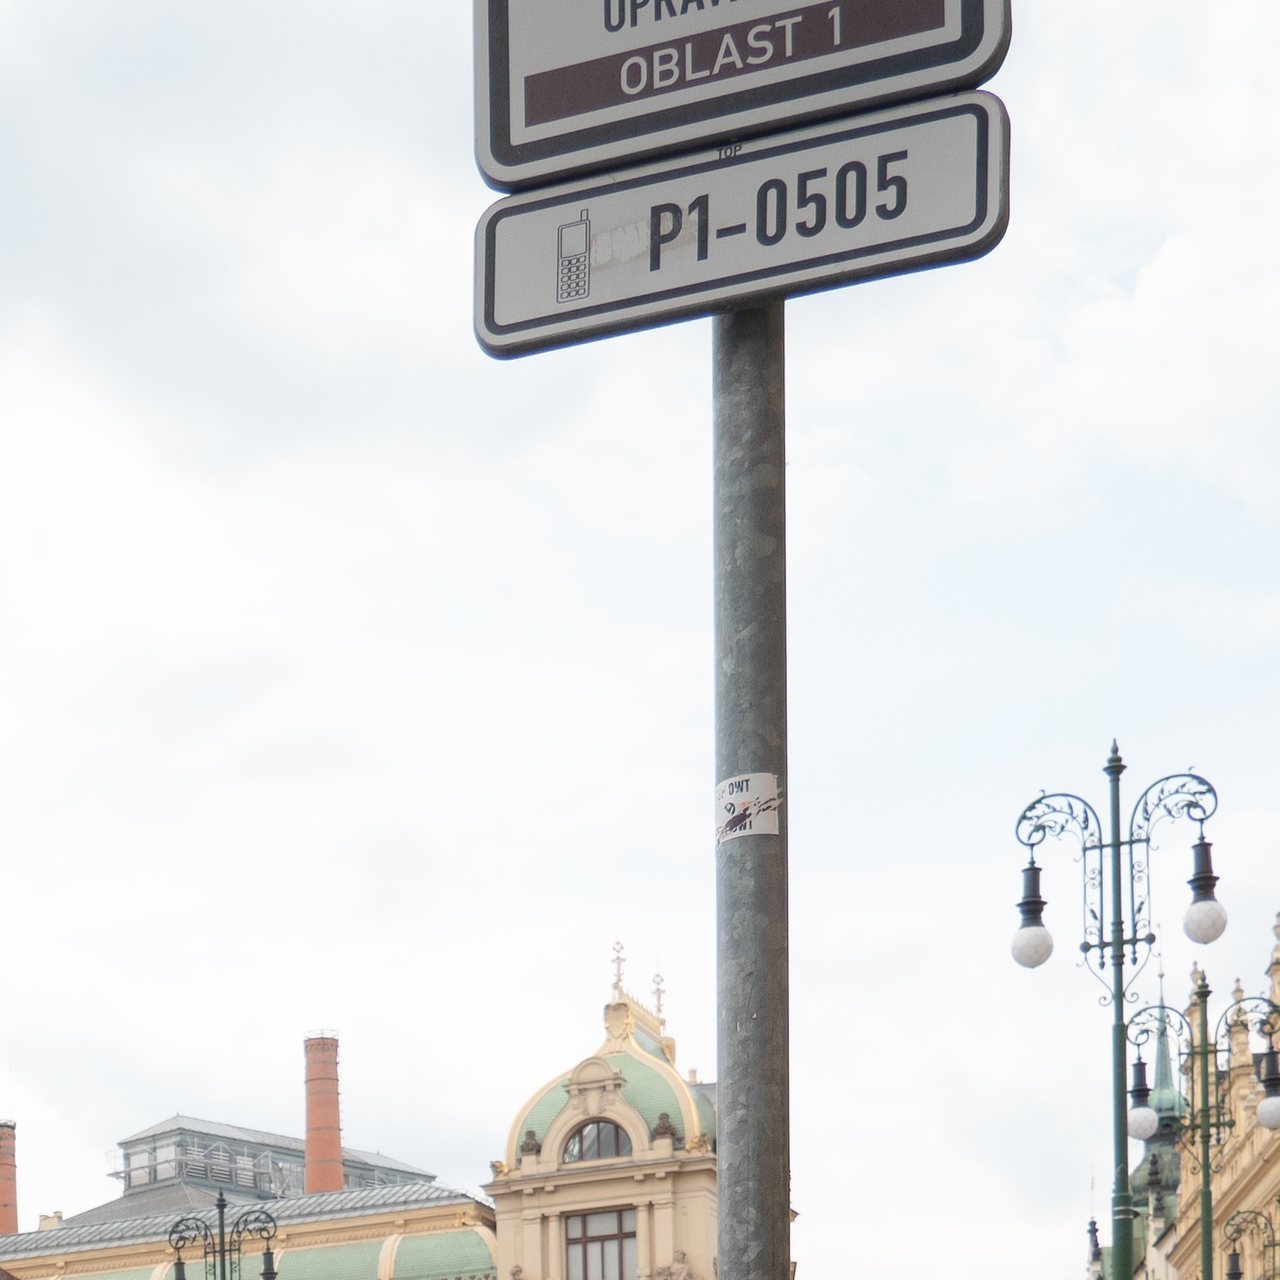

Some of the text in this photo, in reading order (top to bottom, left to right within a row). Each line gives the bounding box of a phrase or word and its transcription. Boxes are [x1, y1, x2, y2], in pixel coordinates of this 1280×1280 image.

[620, 6, 841, 95] OBLAST 1
[649, 149, 908, 271] P1-0505
